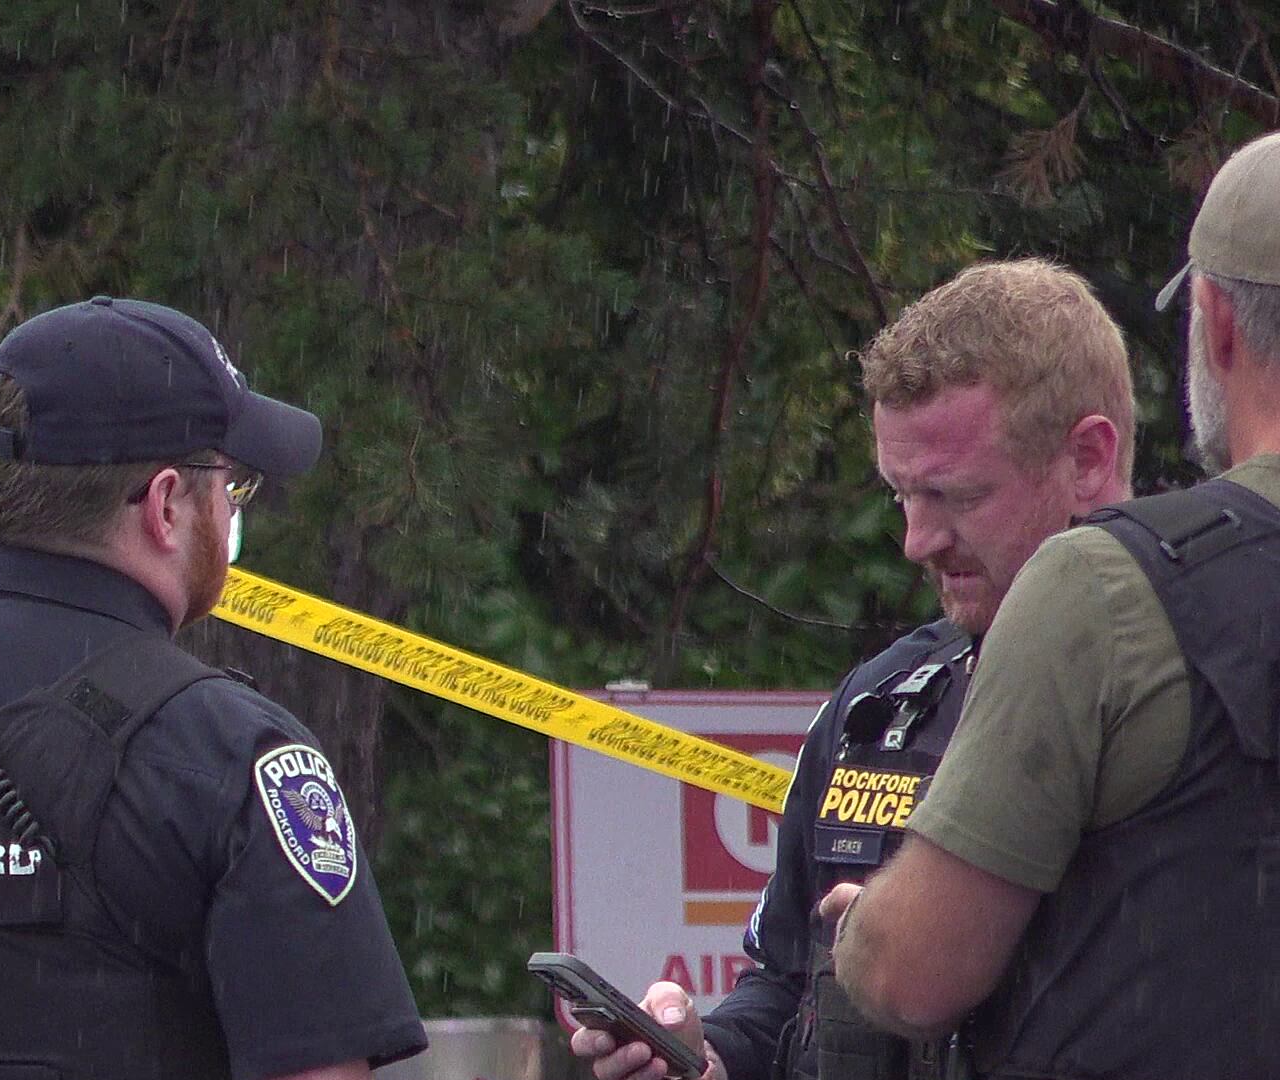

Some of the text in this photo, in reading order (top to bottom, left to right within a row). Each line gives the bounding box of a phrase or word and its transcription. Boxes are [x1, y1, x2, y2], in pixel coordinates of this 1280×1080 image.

[264, 751, 337, 793] POLICE
[266, 788, 312, 866] ROCKFORD
[819, 787, 914, 828] POLICE
